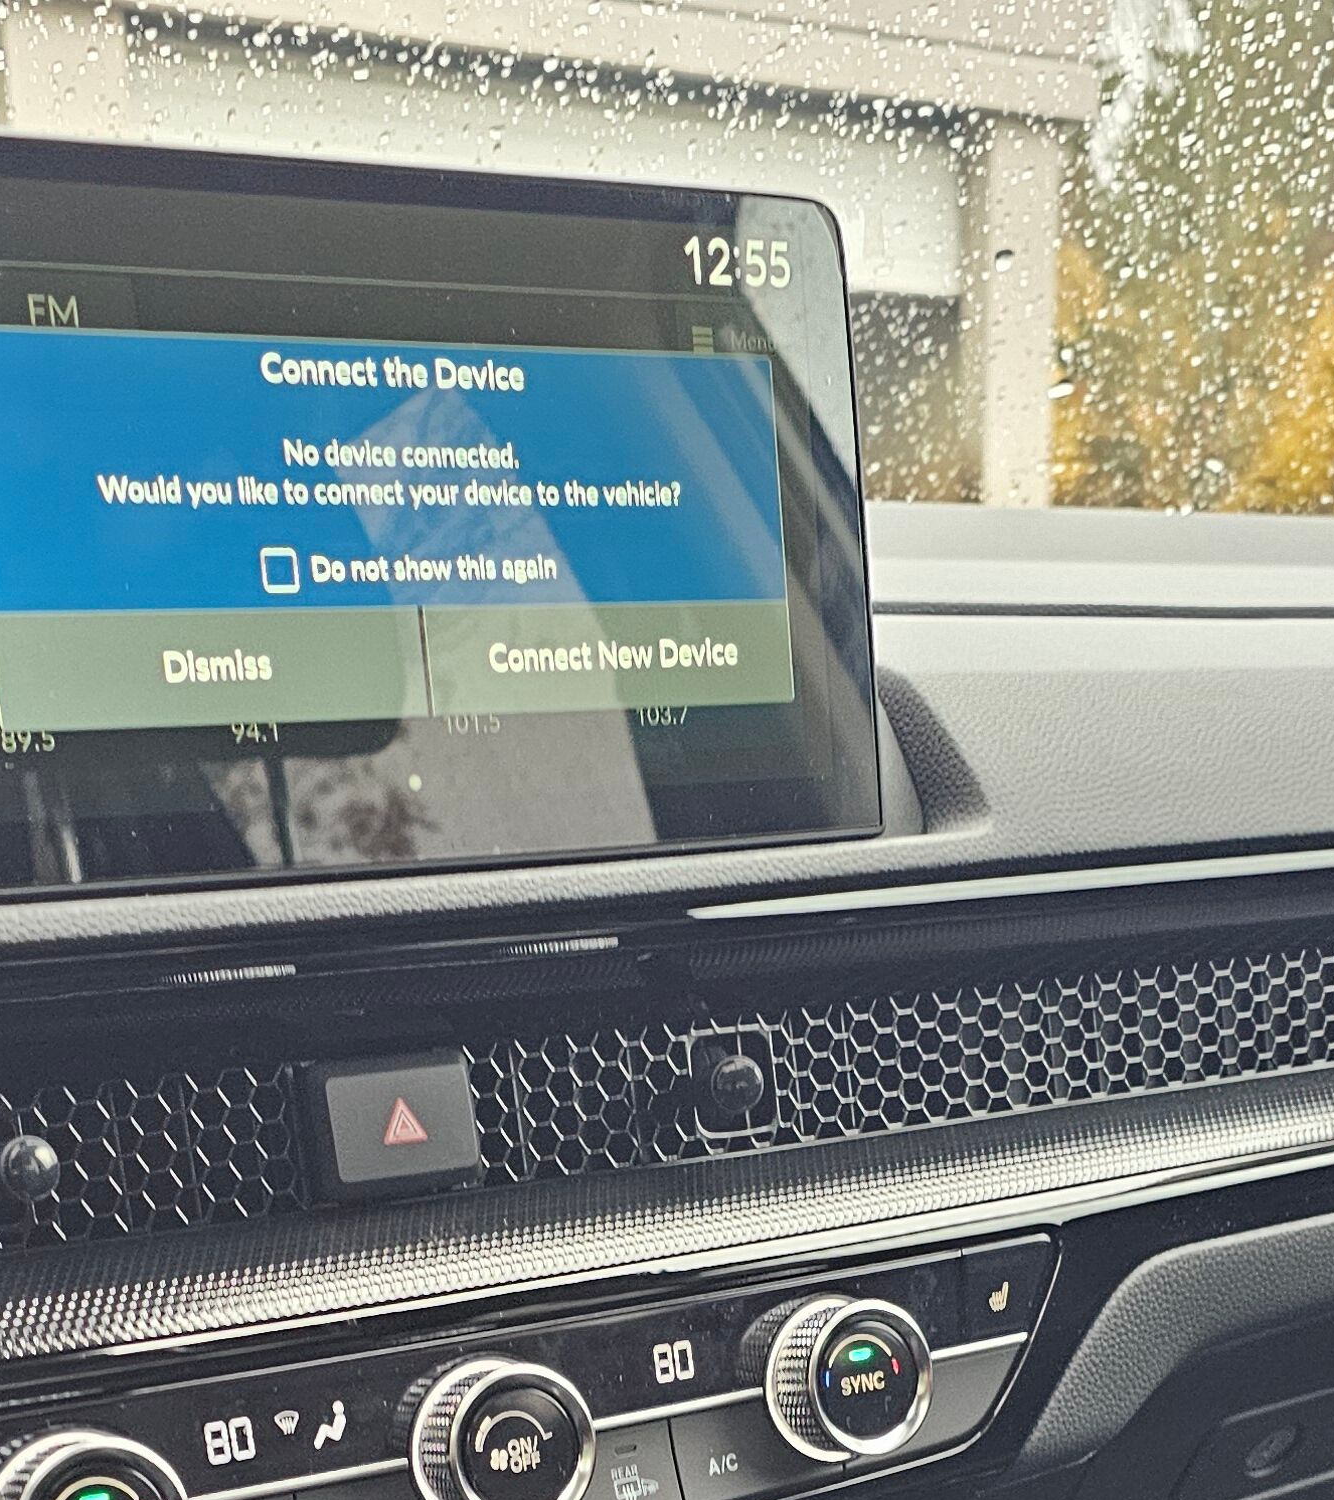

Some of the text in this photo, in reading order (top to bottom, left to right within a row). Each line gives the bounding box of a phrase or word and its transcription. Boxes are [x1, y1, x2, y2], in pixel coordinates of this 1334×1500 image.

[684, 236, 791, 289] 12:55
[27, 293, 79, 328] FM
[260, 351, 526, 392] Connect the Device
[283, 438, 520, 469] No device connected.
[97, 474, 681, 510] Would you like to connect your device to the vehicle?
[310, 553, 557, 585] Do not show this again
[163, 648, 273, 684] Dismiss
[488, 637, 739, 673] Connect New Device
[635, 705, 688, 727] 103.7
[1, 730, 55, 754] 89.5
[231, 722, 279, 744] 94.1
[653, 1339, 695, 1384] 80
[840, 1370, 885, 1397] SYNC
[204, 1416, 256, 1466] 80
[510, 1450, 540, 1474] OFF
[610, 1463, 638, 1480] REAR
[708, 1452, 739, 1477] A/C
